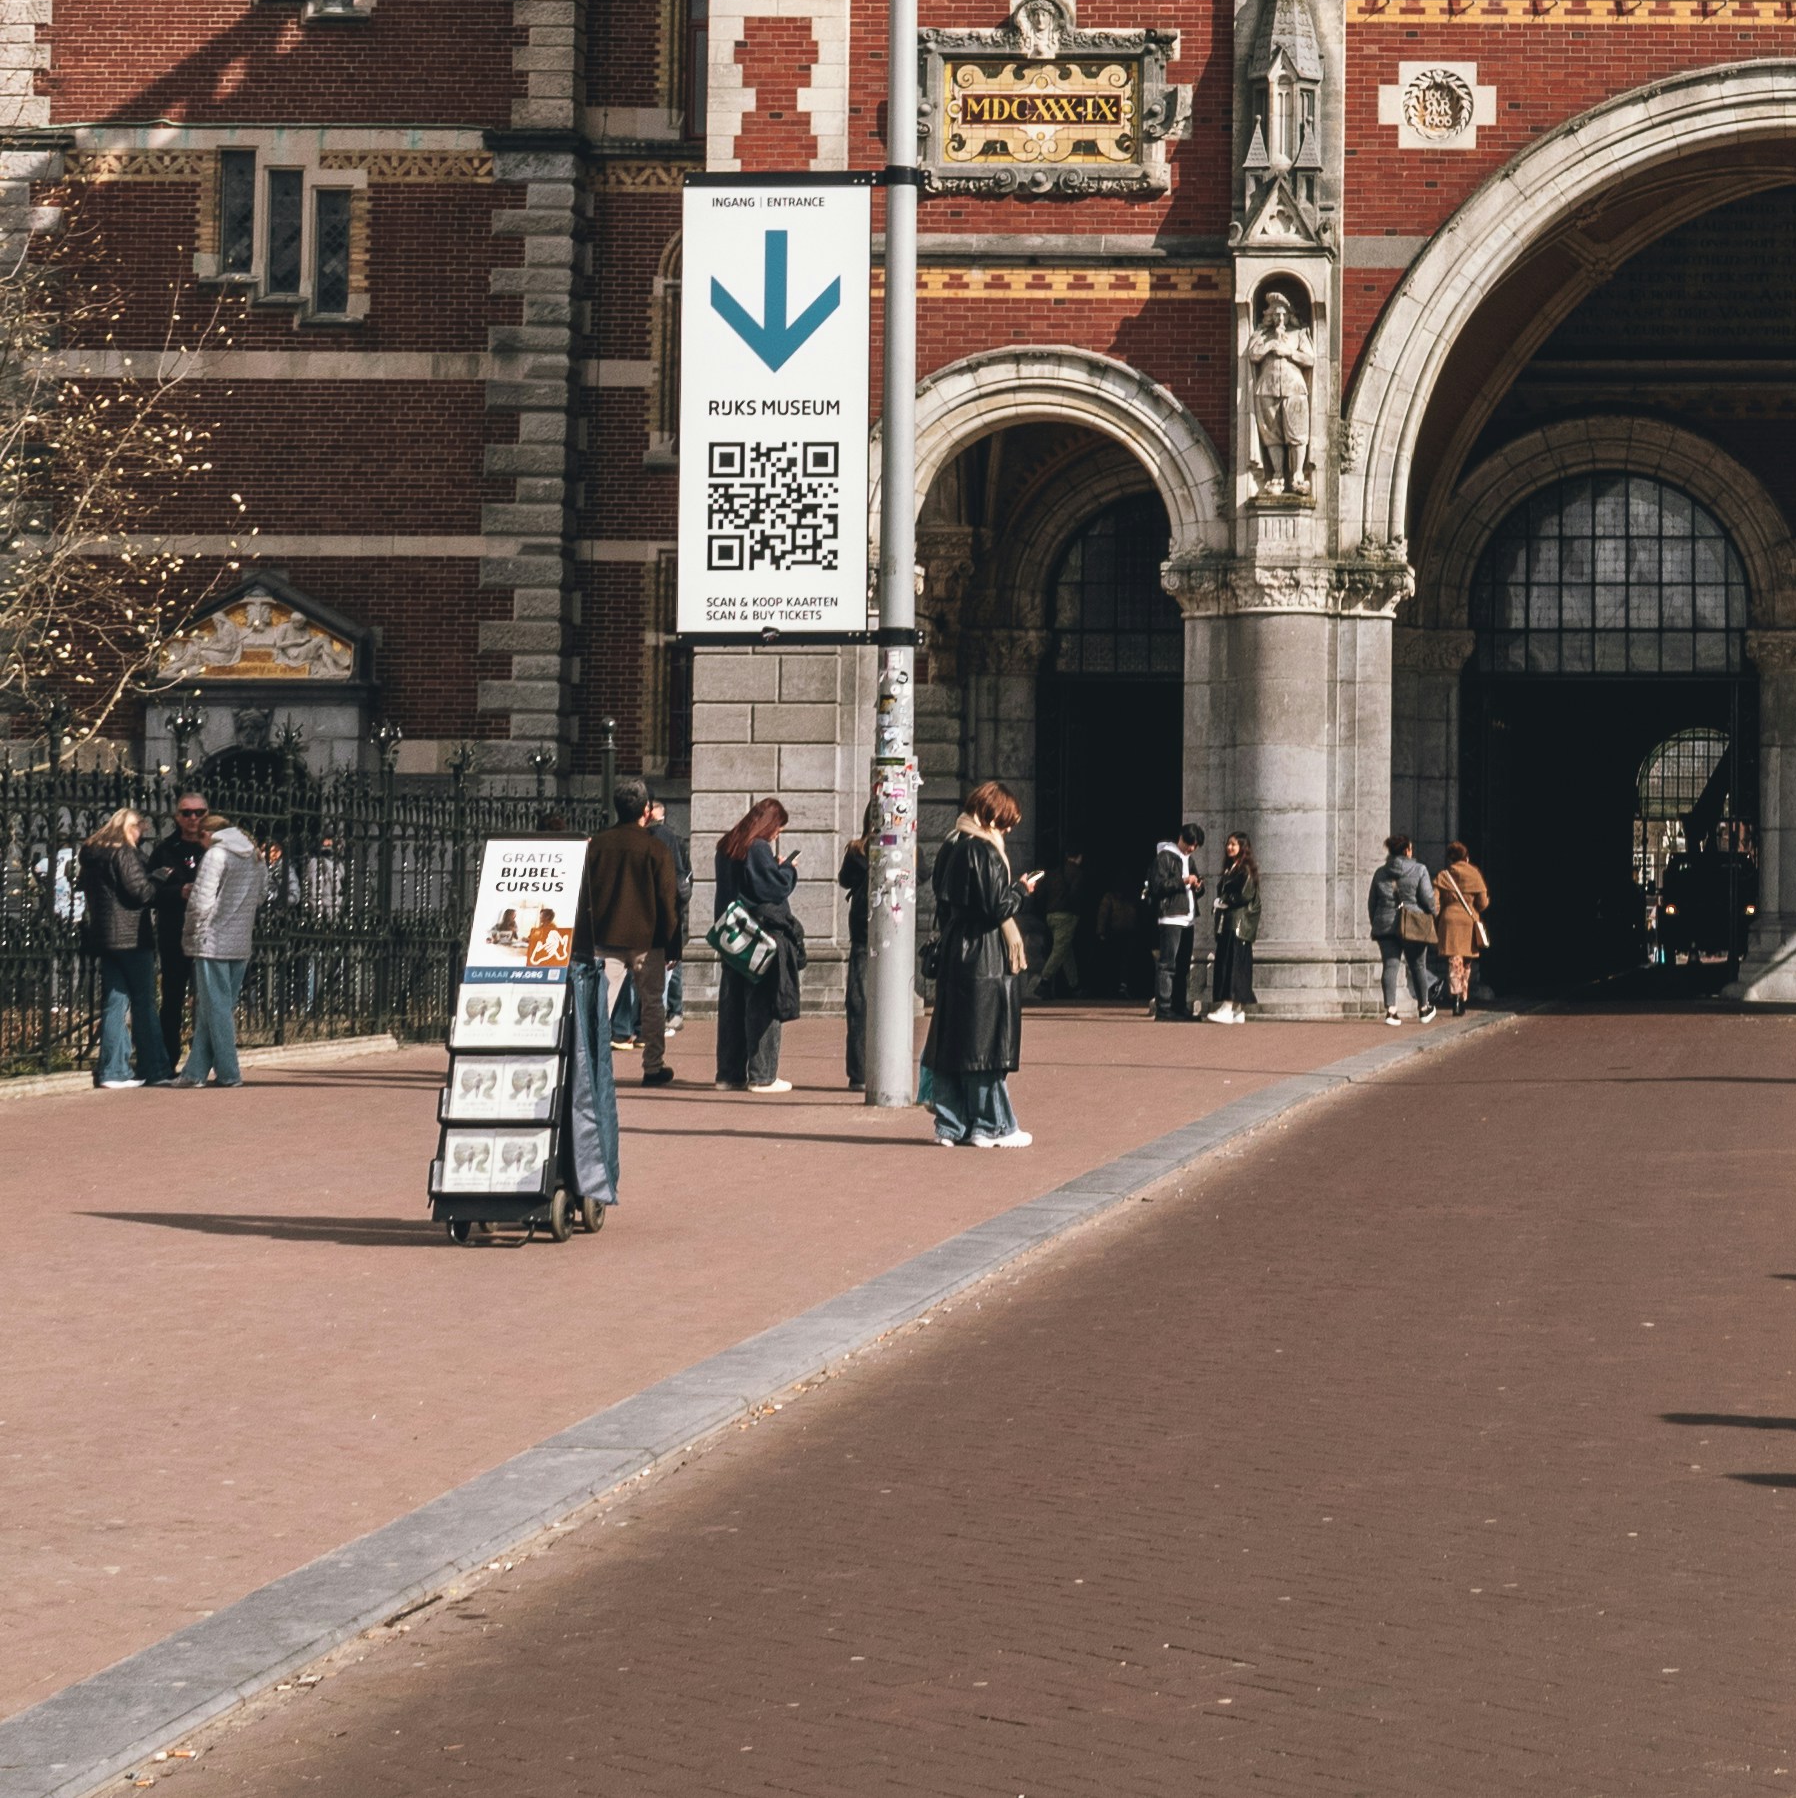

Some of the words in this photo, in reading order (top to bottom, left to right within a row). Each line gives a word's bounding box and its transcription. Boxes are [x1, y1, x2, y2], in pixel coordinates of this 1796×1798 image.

[712, 197, 755, 208] INGANG
[766, 196, 825, 207] ENTRANCE
[708, 399, 757, 416] RIJKS
[761, 399, 840, 416] MUSEUM
[706, 597, 737, 608] SCAN
[739, 597, 748, 608] &
[752, 597, 783, 608] KOOP
[786, 596, 838, 607] KAARTEN
[706, 610, 736, 621] SCAN
[739, 610, 748, 621] &
[752, 610, 775, 621] BUY
[779, 610, 822, 621] TICKETS
[502, 853, 563, 864] GRATIS
[501, 867, 566, 878] BIJBEL-
[495, 881, 564, 893] CURSUS
[509, 970, 543, 979] JW.ORG
